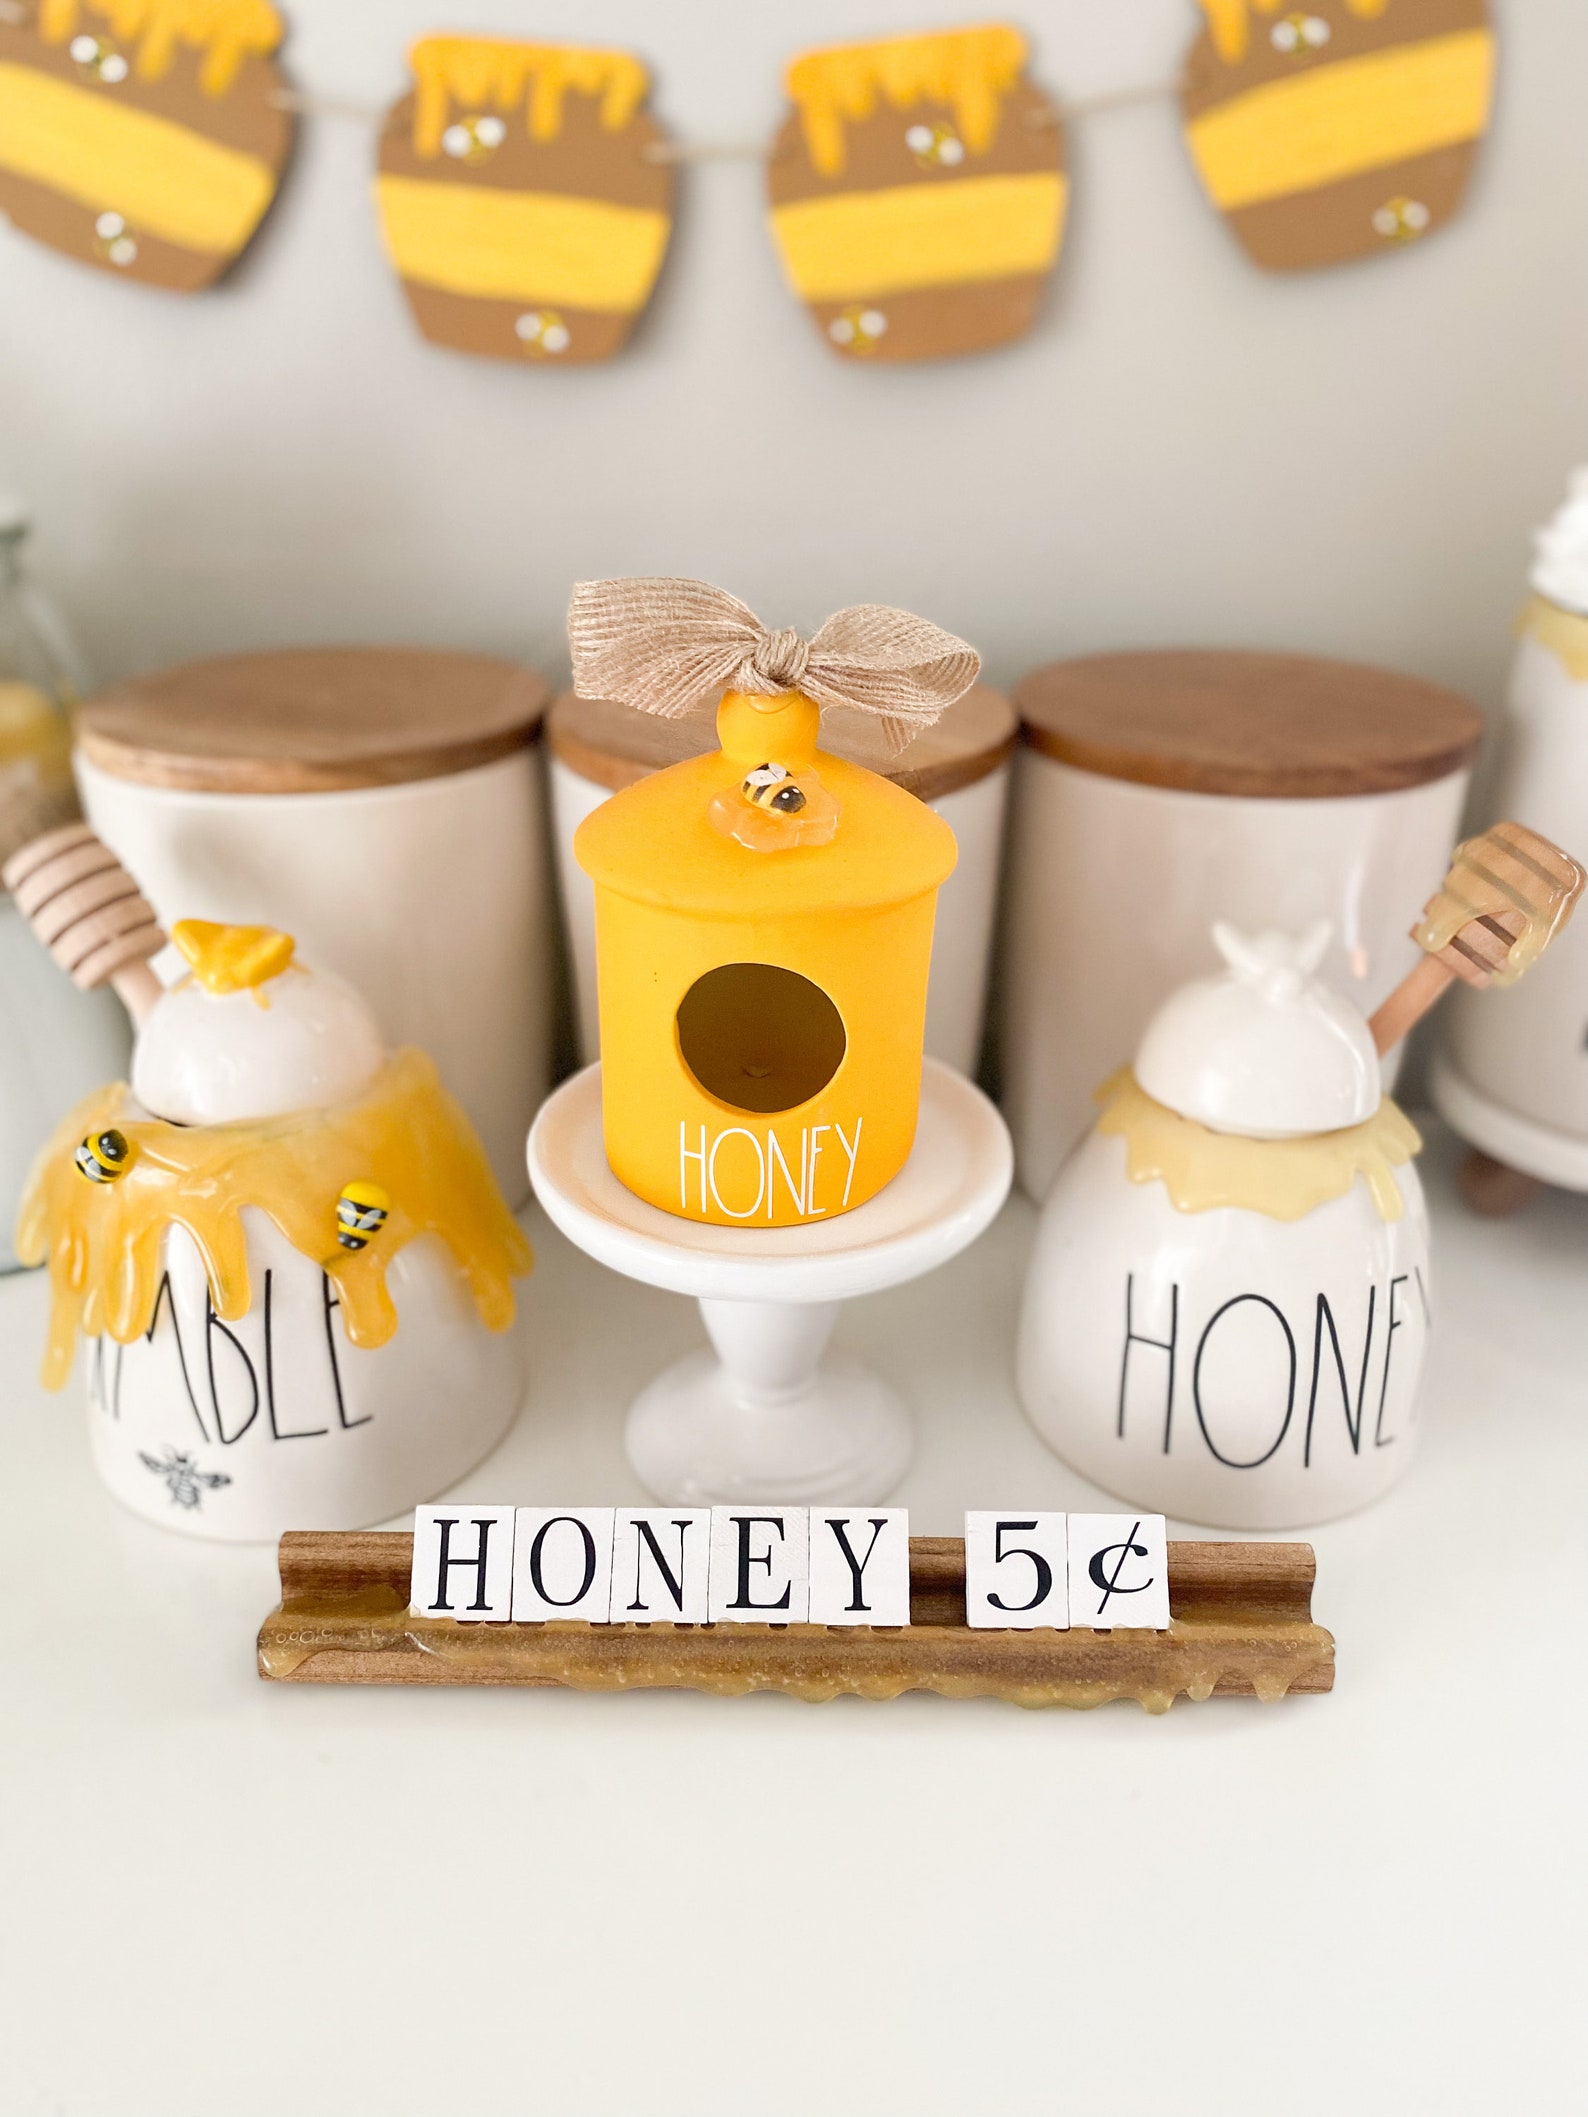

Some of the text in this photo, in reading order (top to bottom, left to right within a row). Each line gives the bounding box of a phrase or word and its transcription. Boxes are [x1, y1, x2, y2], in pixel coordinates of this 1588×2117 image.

[679, 1116, 863, 1219] HONEY
[91, 1268, 374, 1445] MBLE
[428, 1517, 1155, 1615] HONEY 5¢
